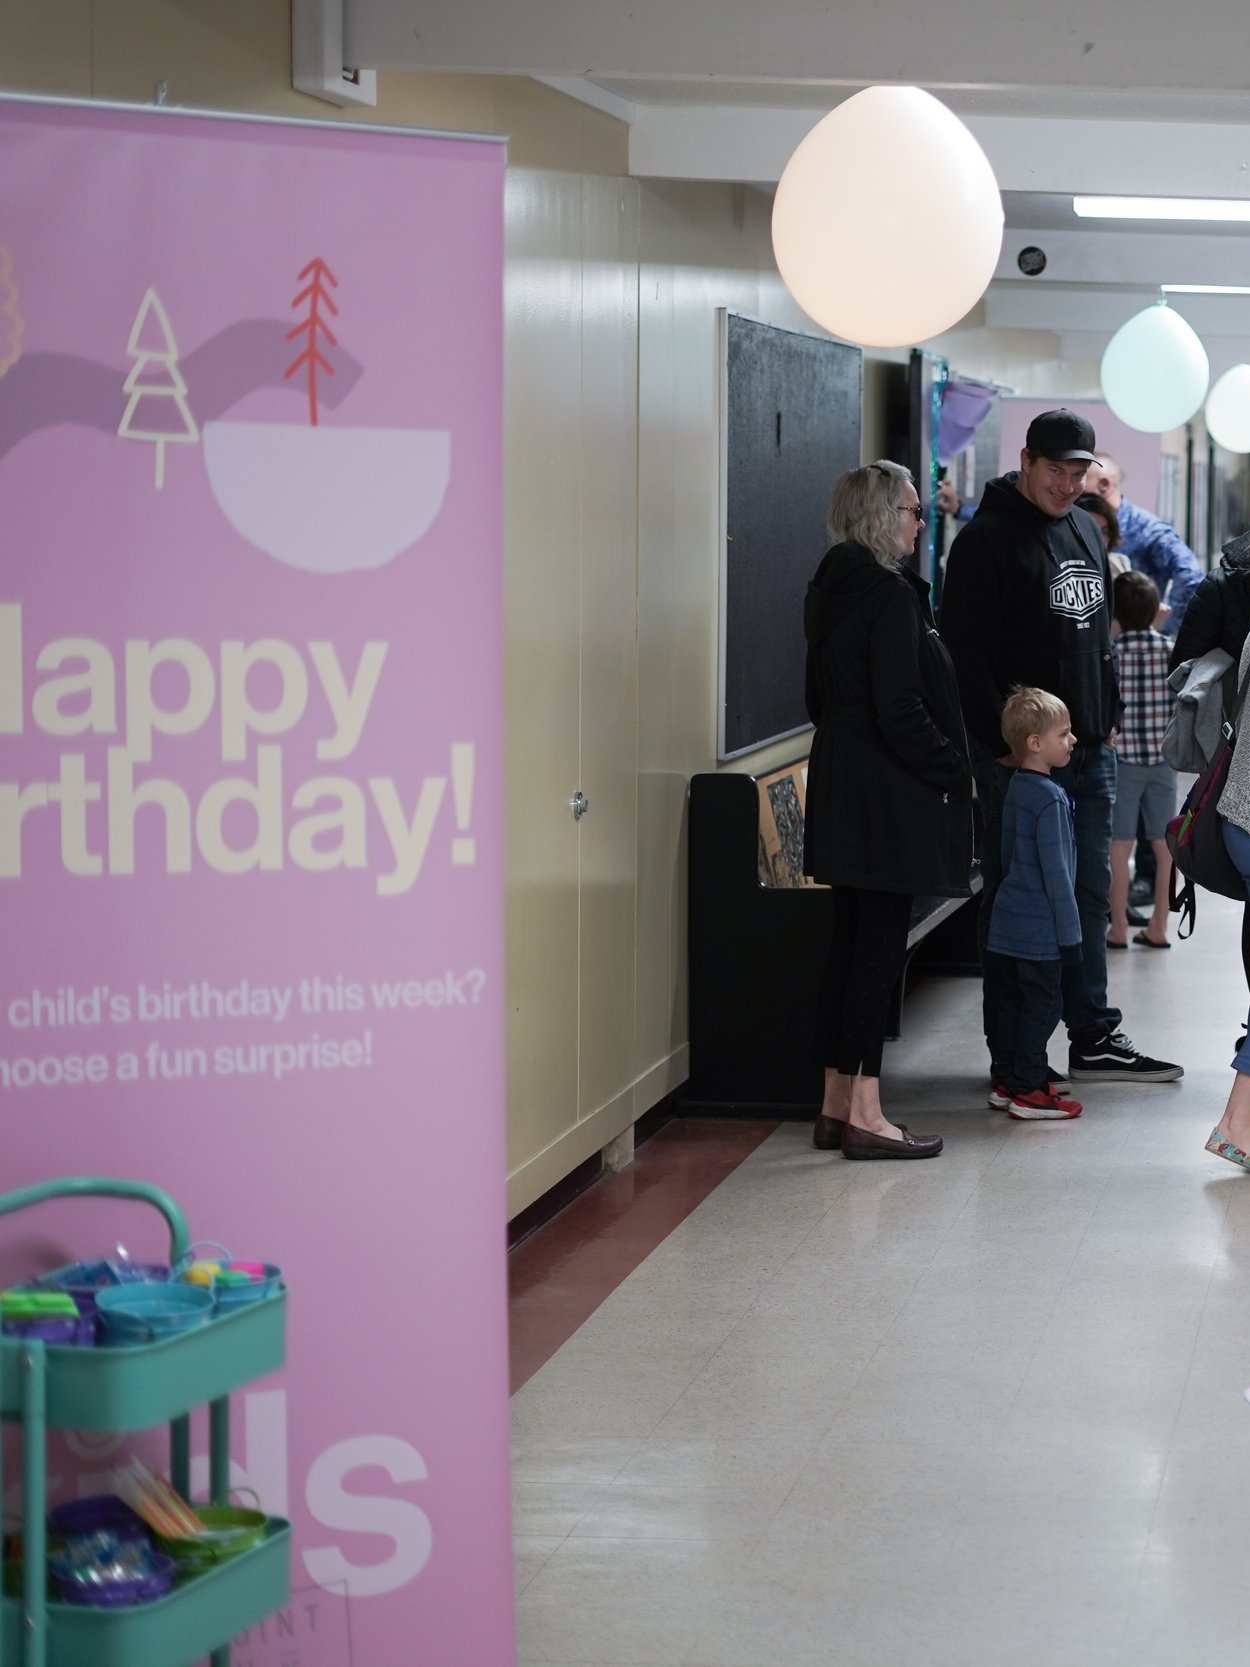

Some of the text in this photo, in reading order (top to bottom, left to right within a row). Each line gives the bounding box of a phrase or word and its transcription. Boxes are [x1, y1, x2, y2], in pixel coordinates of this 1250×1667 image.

[1055, 580, 1101, 608] DICKIES
[0, 742, 476, 896] rthday!
[7, 967, 487, 1029] child's birthday this week?
[0, 1030, 373, 1088] oose a fun surprise!
